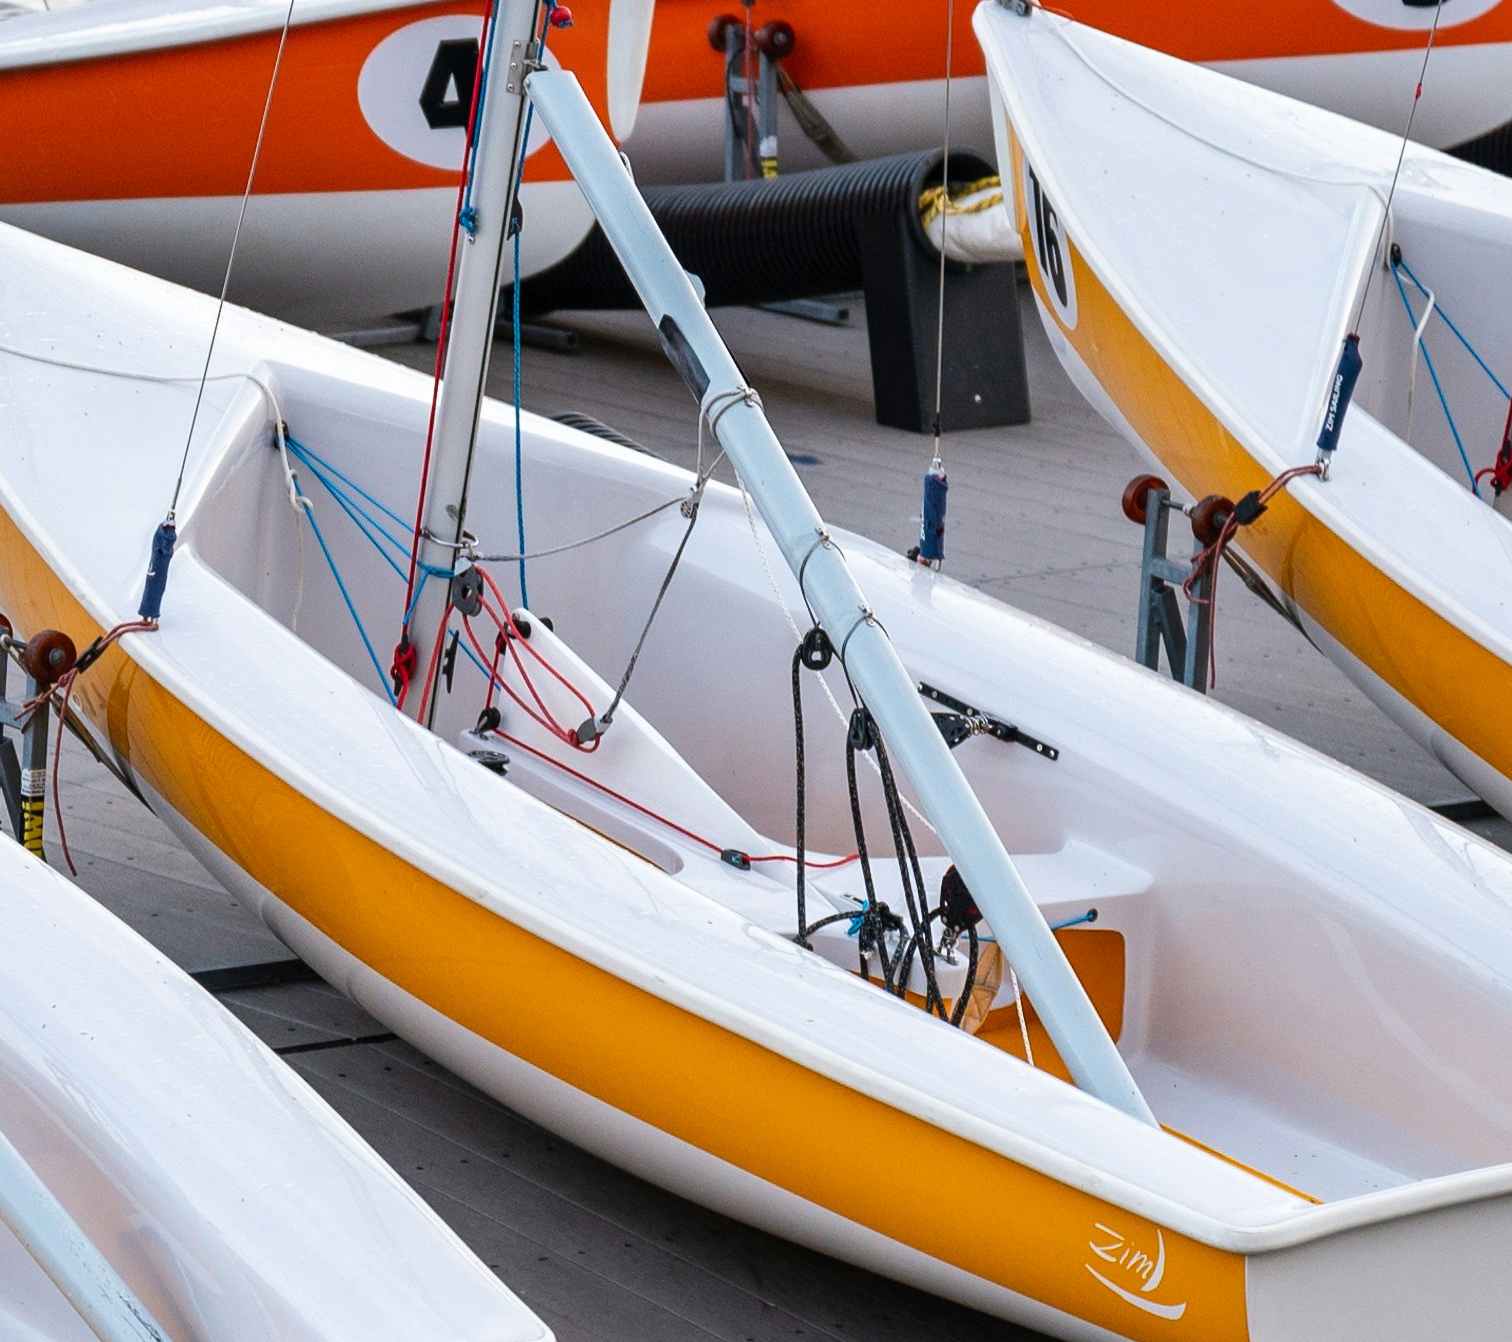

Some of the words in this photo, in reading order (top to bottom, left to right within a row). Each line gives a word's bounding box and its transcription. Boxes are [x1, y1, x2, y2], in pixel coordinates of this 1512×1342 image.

[419, 37, 485, 149] 4
[1029, 163, 1068, 308] 16
[1330, 374, 1344, 413] SAILING
[1326, 412, 1336, 432] ZIM
[1088, 1223, 1153, 1279] Zim
